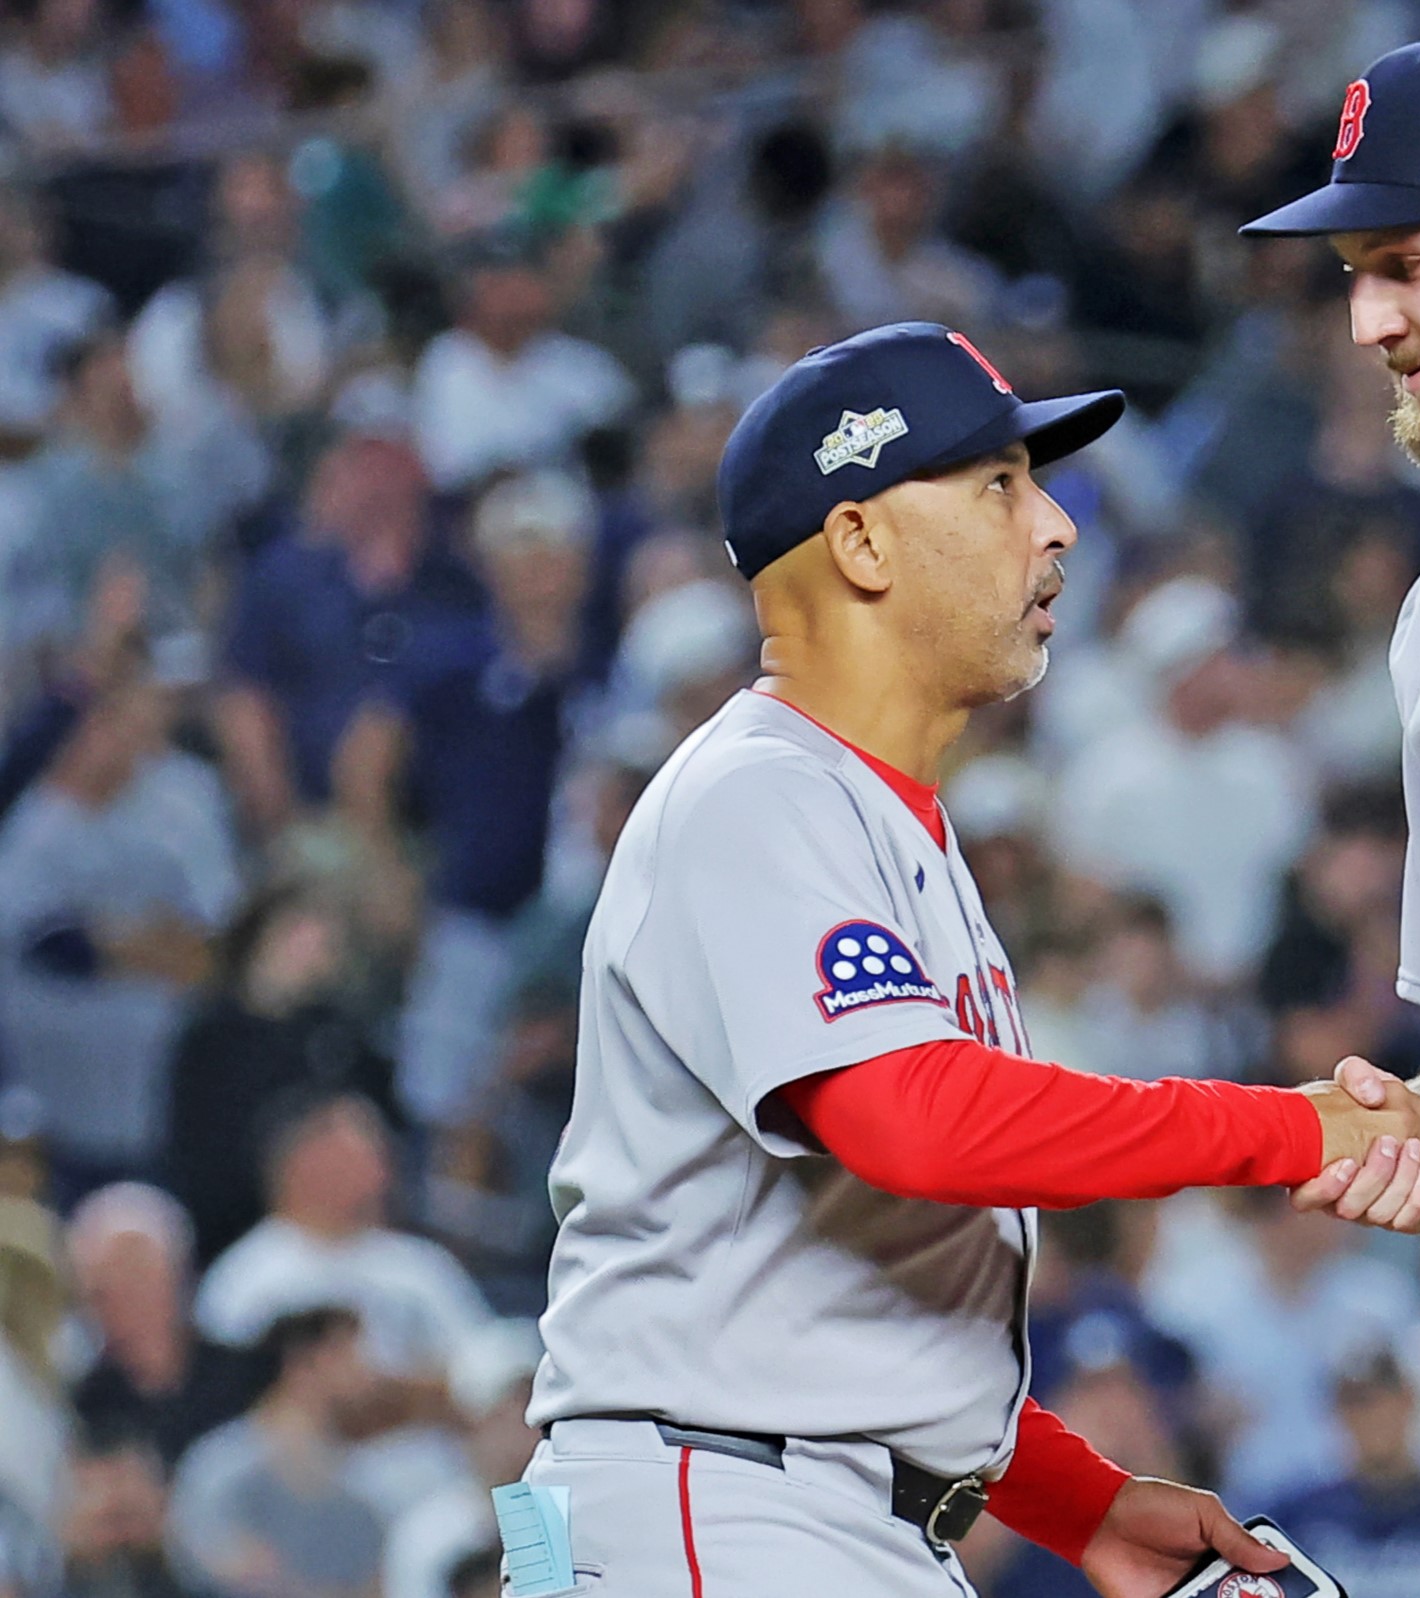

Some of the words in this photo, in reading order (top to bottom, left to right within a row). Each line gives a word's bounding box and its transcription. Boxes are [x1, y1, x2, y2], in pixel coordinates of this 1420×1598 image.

[1332, 78, 1372, 162] B
[820, 415, 902, 467] POSTSEASON
[822, 980, 943, 1014] MassMutual
[1222, 1574, 1259, 1598] OSTON
